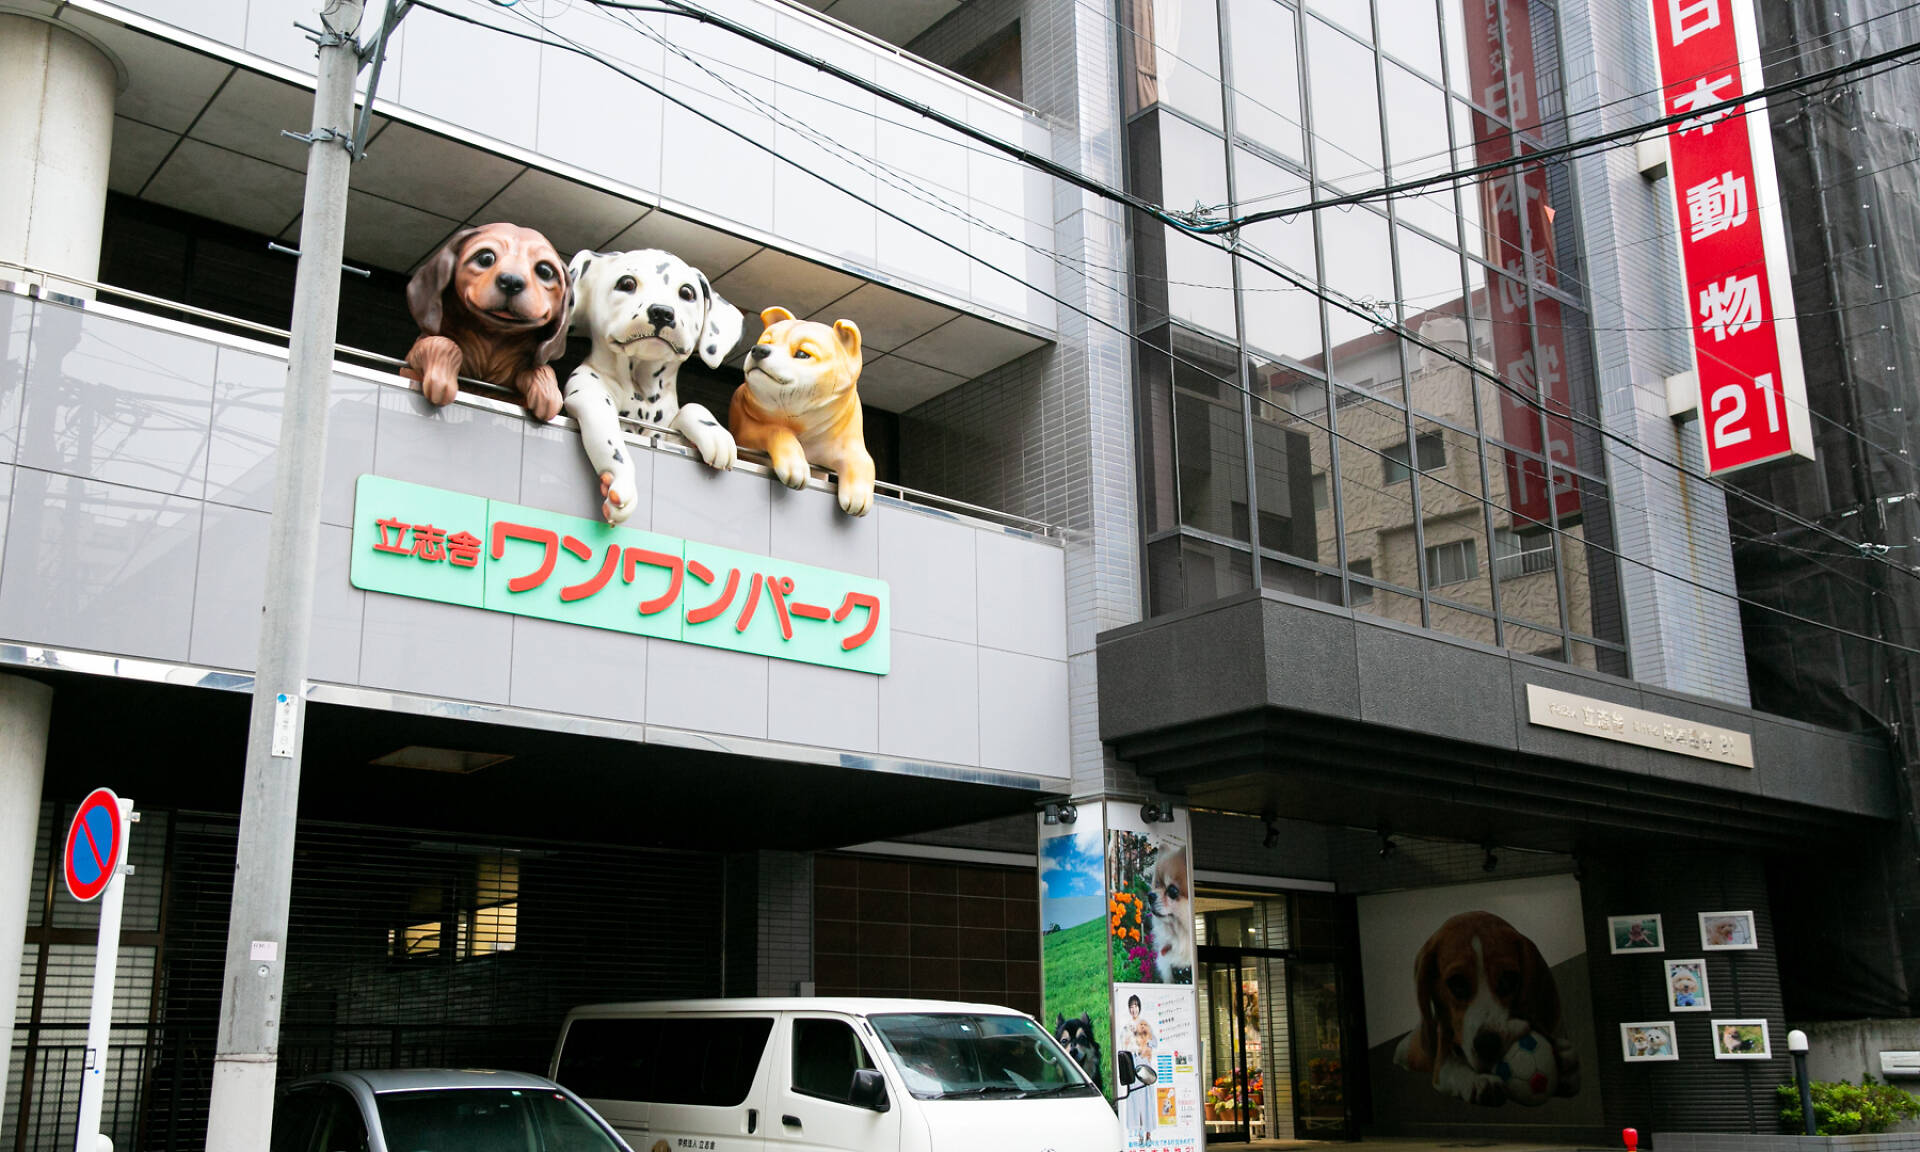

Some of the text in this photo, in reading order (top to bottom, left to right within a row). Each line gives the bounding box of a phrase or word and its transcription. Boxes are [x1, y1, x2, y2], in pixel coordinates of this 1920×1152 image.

[373, 516, 880, 650] 立志舎 ワンワンパーク
